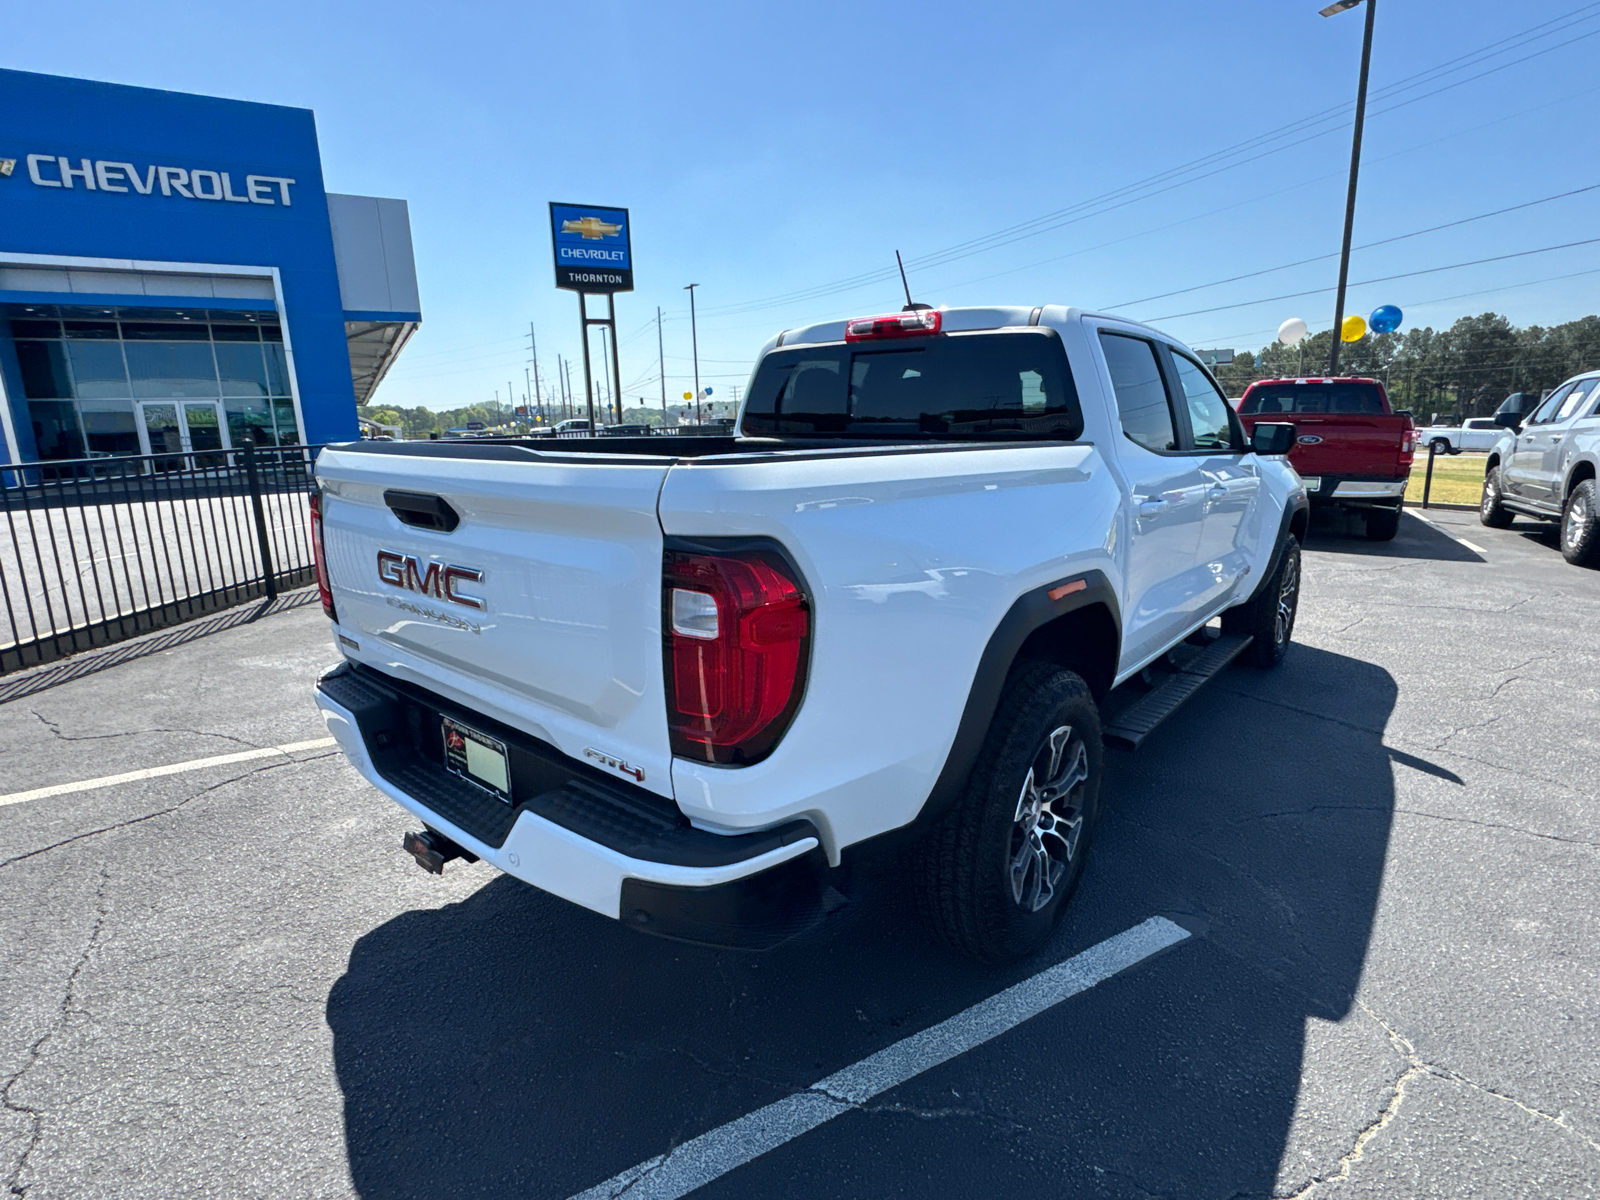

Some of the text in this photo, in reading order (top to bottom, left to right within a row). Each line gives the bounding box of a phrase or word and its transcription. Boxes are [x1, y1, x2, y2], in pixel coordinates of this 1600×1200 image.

[27, 153, 296, 206] CHEVROLET
[560, 247, 625, 261] CHEVROLET
[568, 272, 622, 284] THORNTON
[377, 548, 488, 612] GMC
[386, 597, 482, 635] CANYON
[582, 746, 646, 782] AT4
